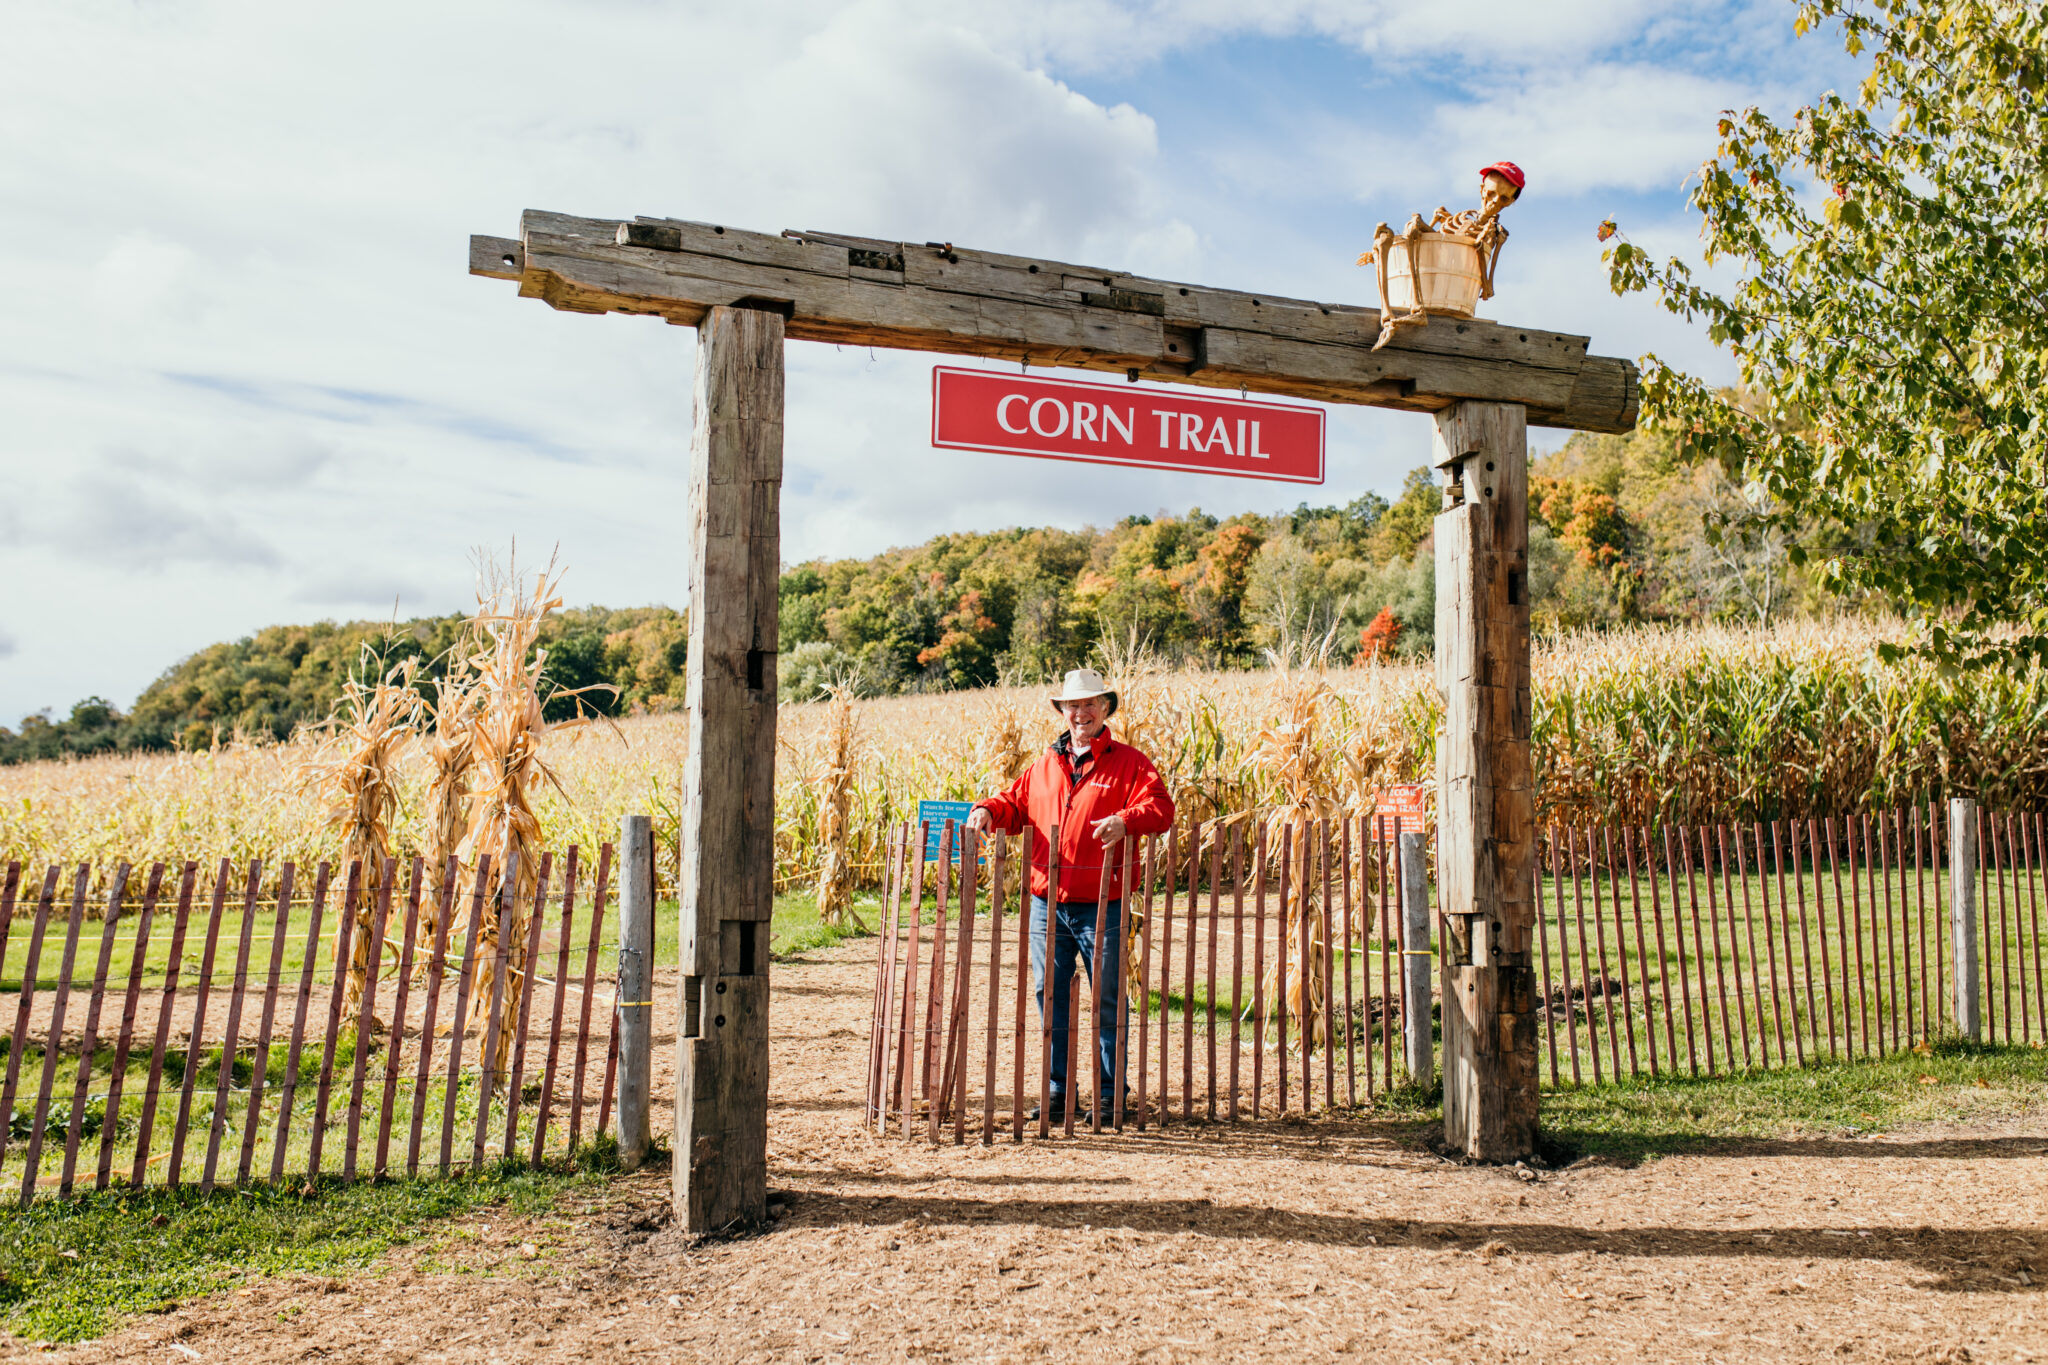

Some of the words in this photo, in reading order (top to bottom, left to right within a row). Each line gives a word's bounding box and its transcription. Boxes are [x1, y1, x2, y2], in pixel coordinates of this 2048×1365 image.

[996, 393, 1134, 445] CORN
[1151, 409, 1270, 459] TRAIL
[1375, 804, 1397, 812] CORN
